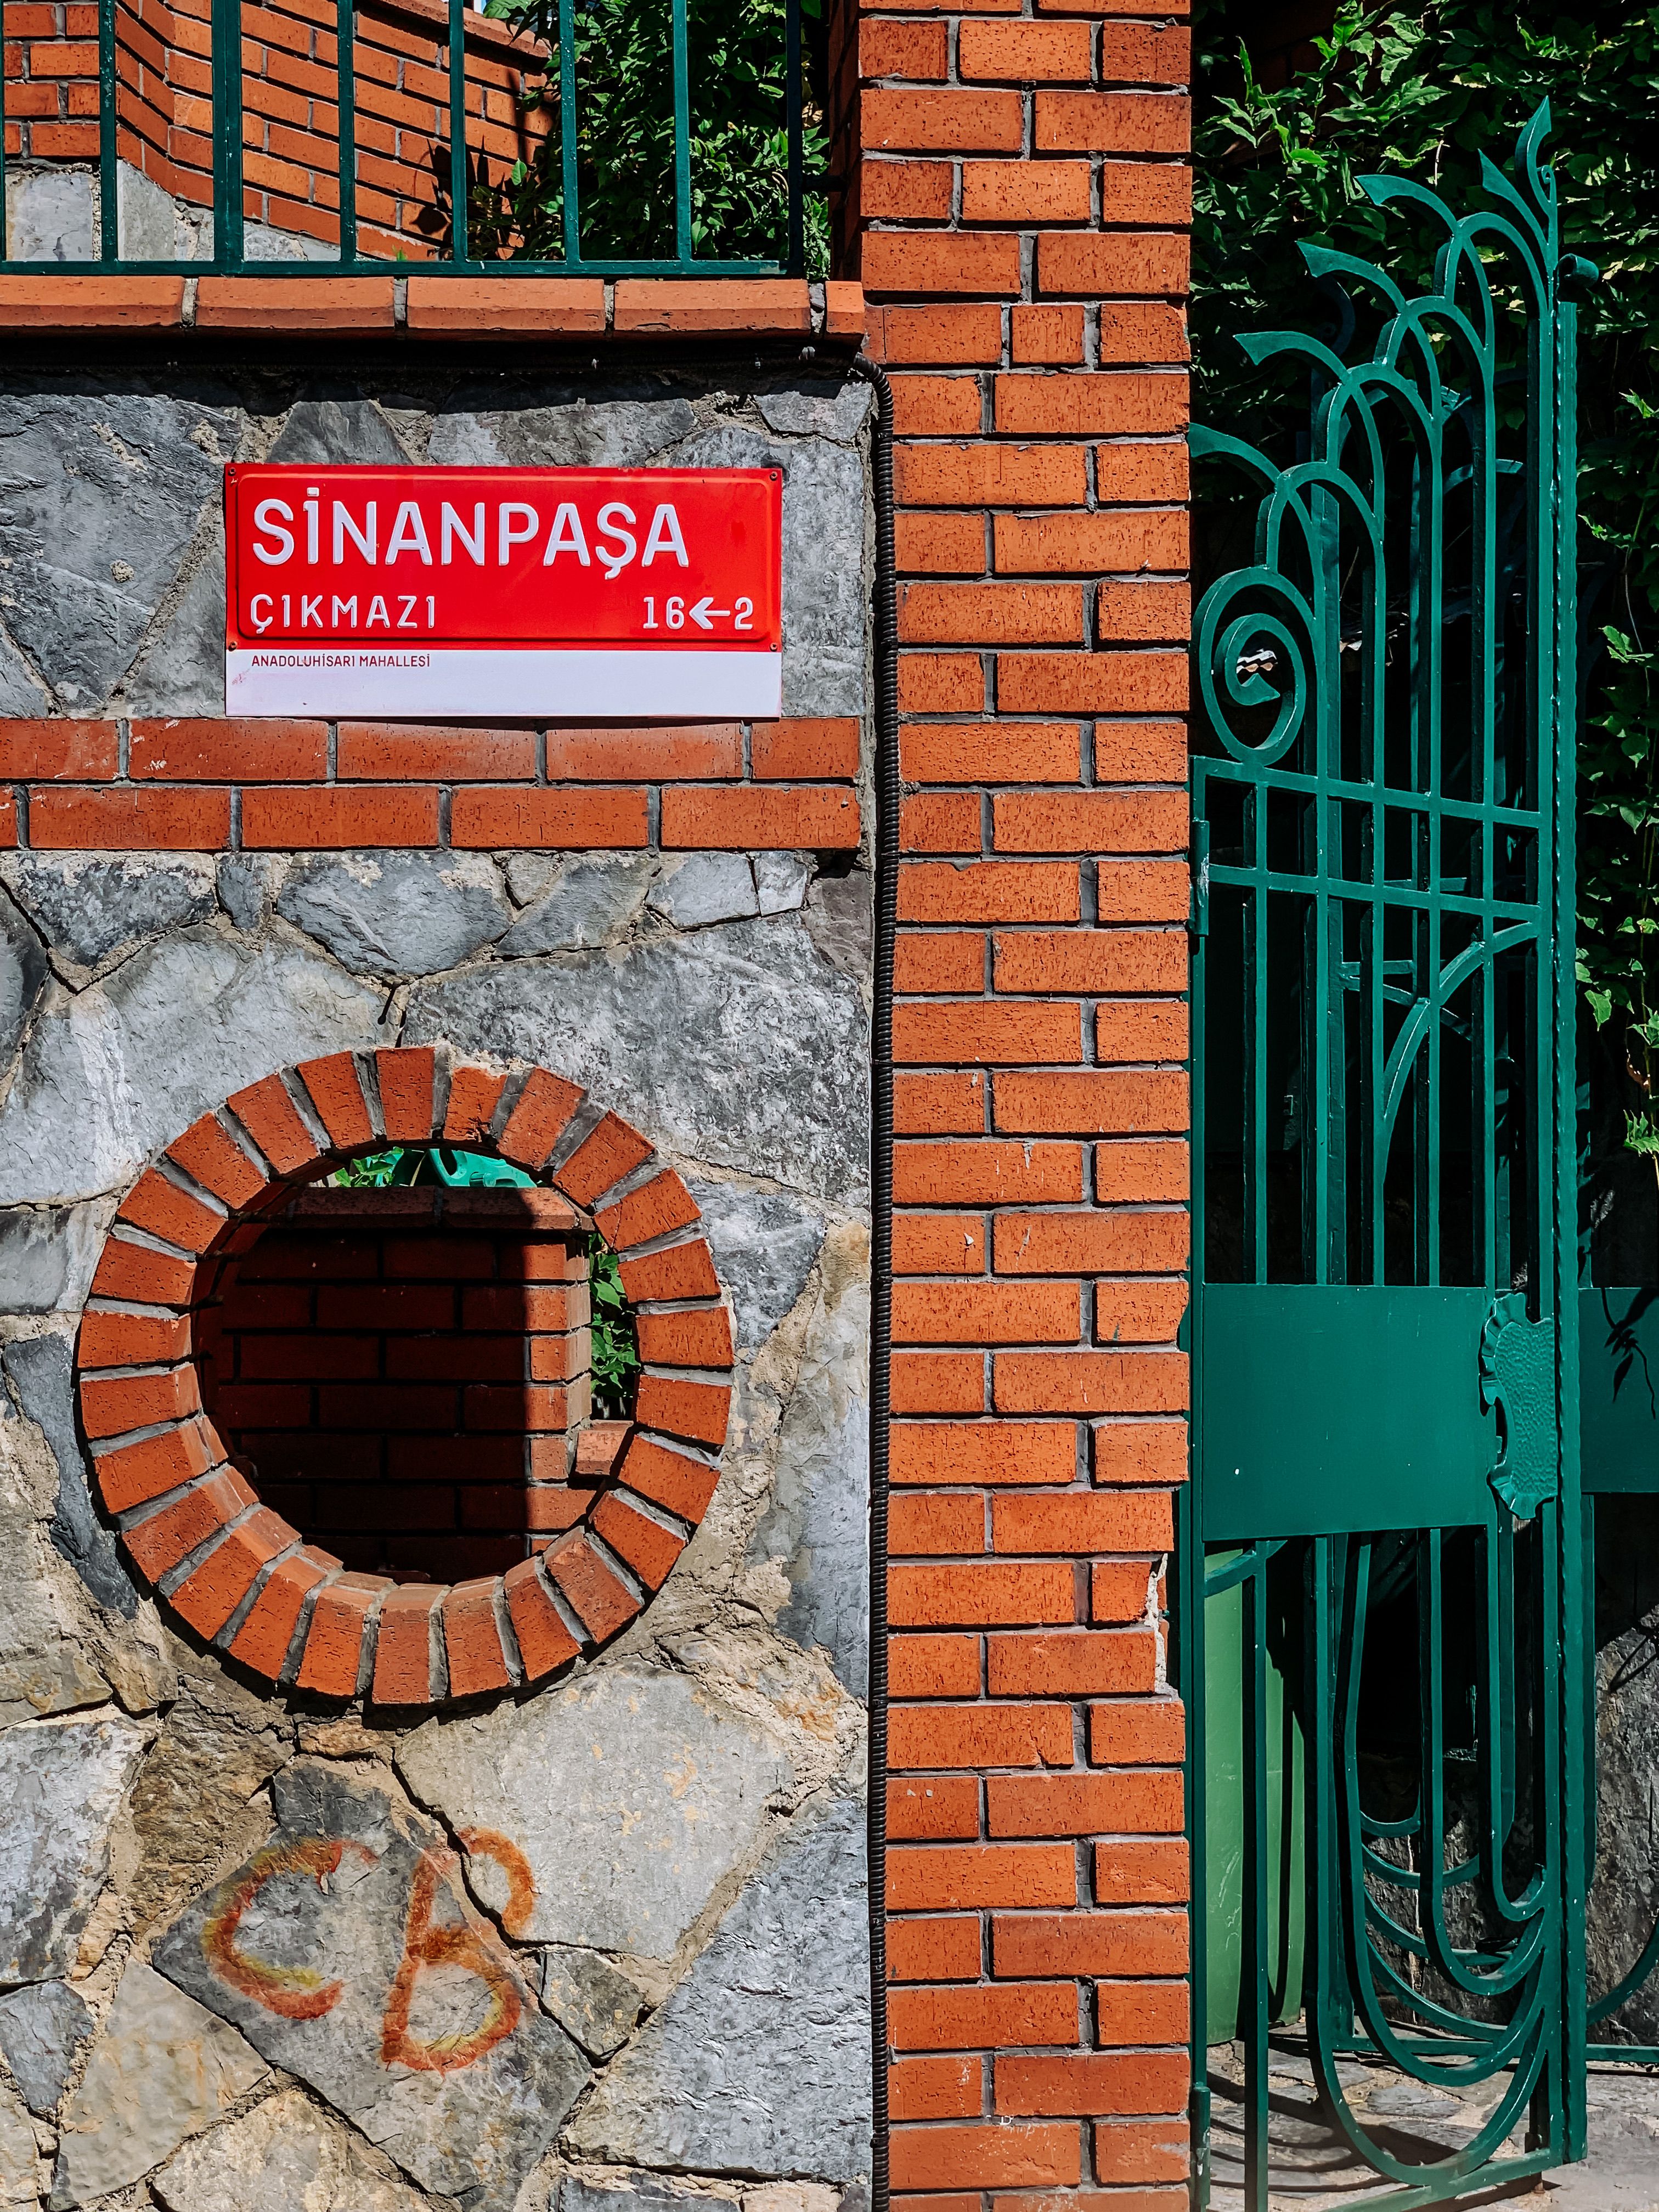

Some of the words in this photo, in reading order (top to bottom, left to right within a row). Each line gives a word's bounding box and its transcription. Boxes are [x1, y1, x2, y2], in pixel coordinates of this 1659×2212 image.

[253, 487, 689, 580] SİNANPAŞA
[250, 594, 436, 634] ÇIKMAZI
[643, 596, 685, 630] 16
[734, 596, 753, 630] 2
[251, 653, 356, 667] ANADOLUHİSARI
[359, 653, 430, 667] MAHALLESİ
